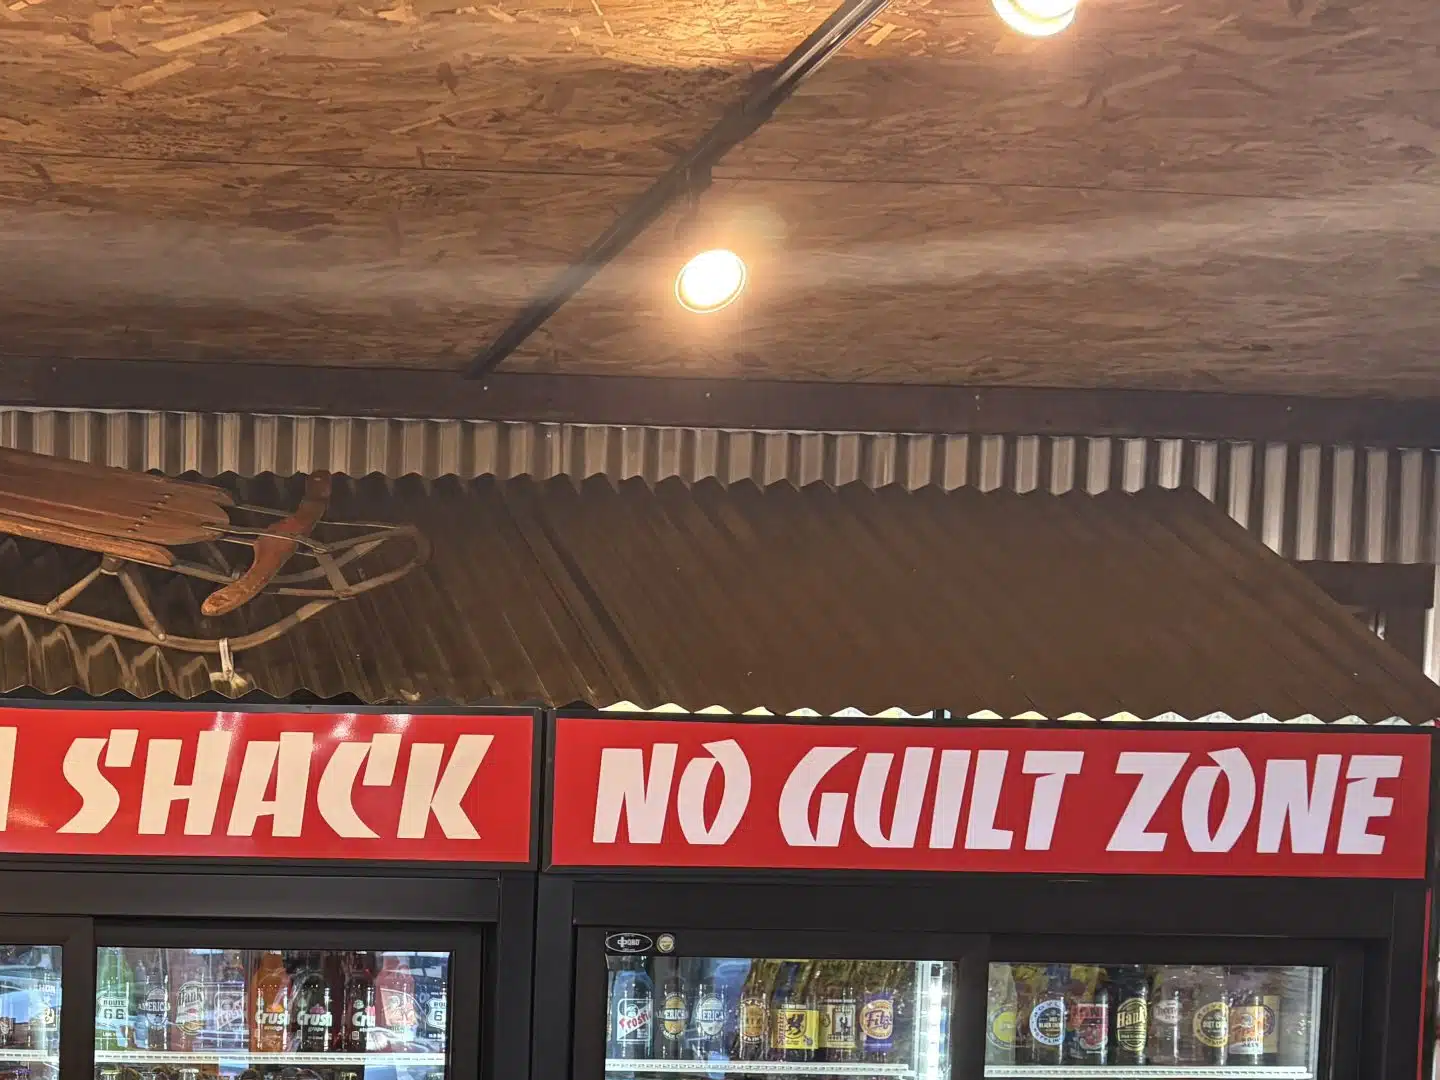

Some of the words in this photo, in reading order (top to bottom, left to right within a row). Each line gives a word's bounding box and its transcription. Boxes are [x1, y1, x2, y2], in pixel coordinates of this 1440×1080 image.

[56, 728, 494, 840] SHACK
[593, 738, 752, 845] NO
[778, 747, 1085, 851] GUILT
[1105, 747, 1404, 855] ZONE
[103, 1008, 124, 1020] 66
[297, 1012, 333, 1026] Crush
